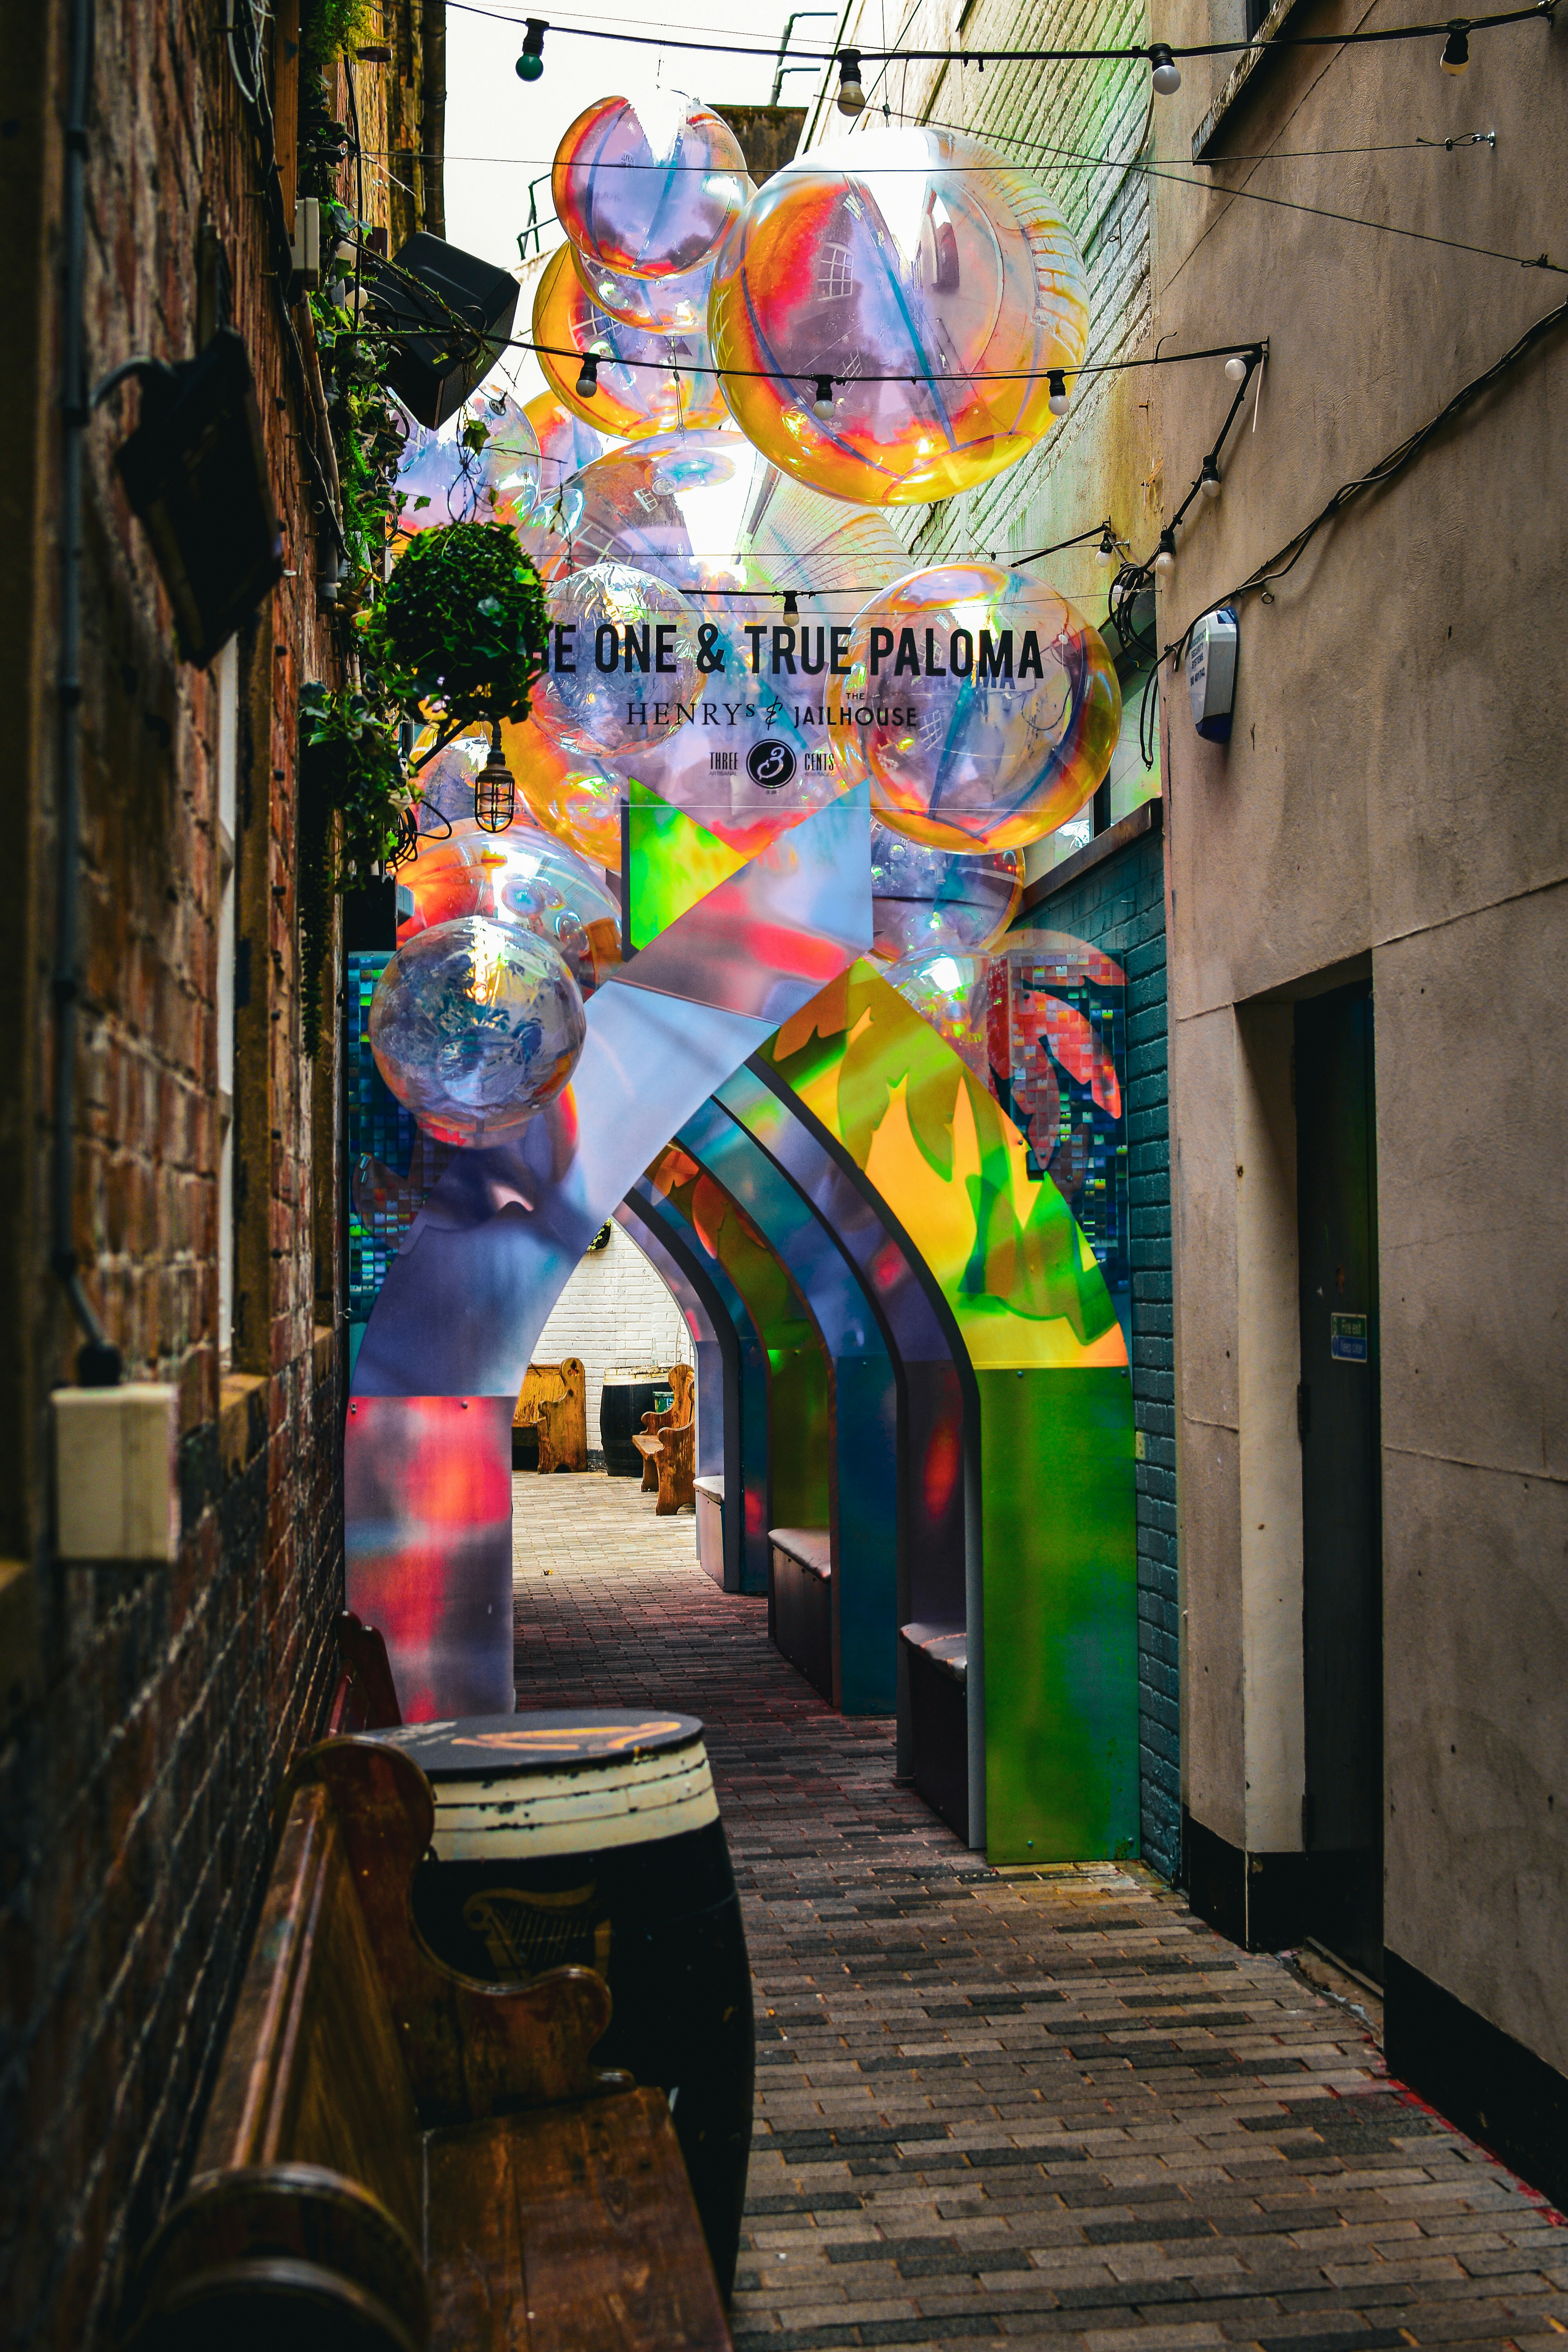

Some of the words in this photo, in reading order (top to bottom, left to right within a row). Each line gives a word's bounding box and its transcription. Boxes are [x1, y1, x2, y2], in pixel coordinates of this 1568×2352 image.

[595, 624, 677, 673] ONE
[696, 623, 725, 673] &
[744, 626, 851, 675] TRUE
[870, 627, 1044, 679] PALOMA
[793, 706, 916, 729] JAILHOUSE
[710, 752, 738, 770] THREE
[804, 753, 834, 771] CENTS
